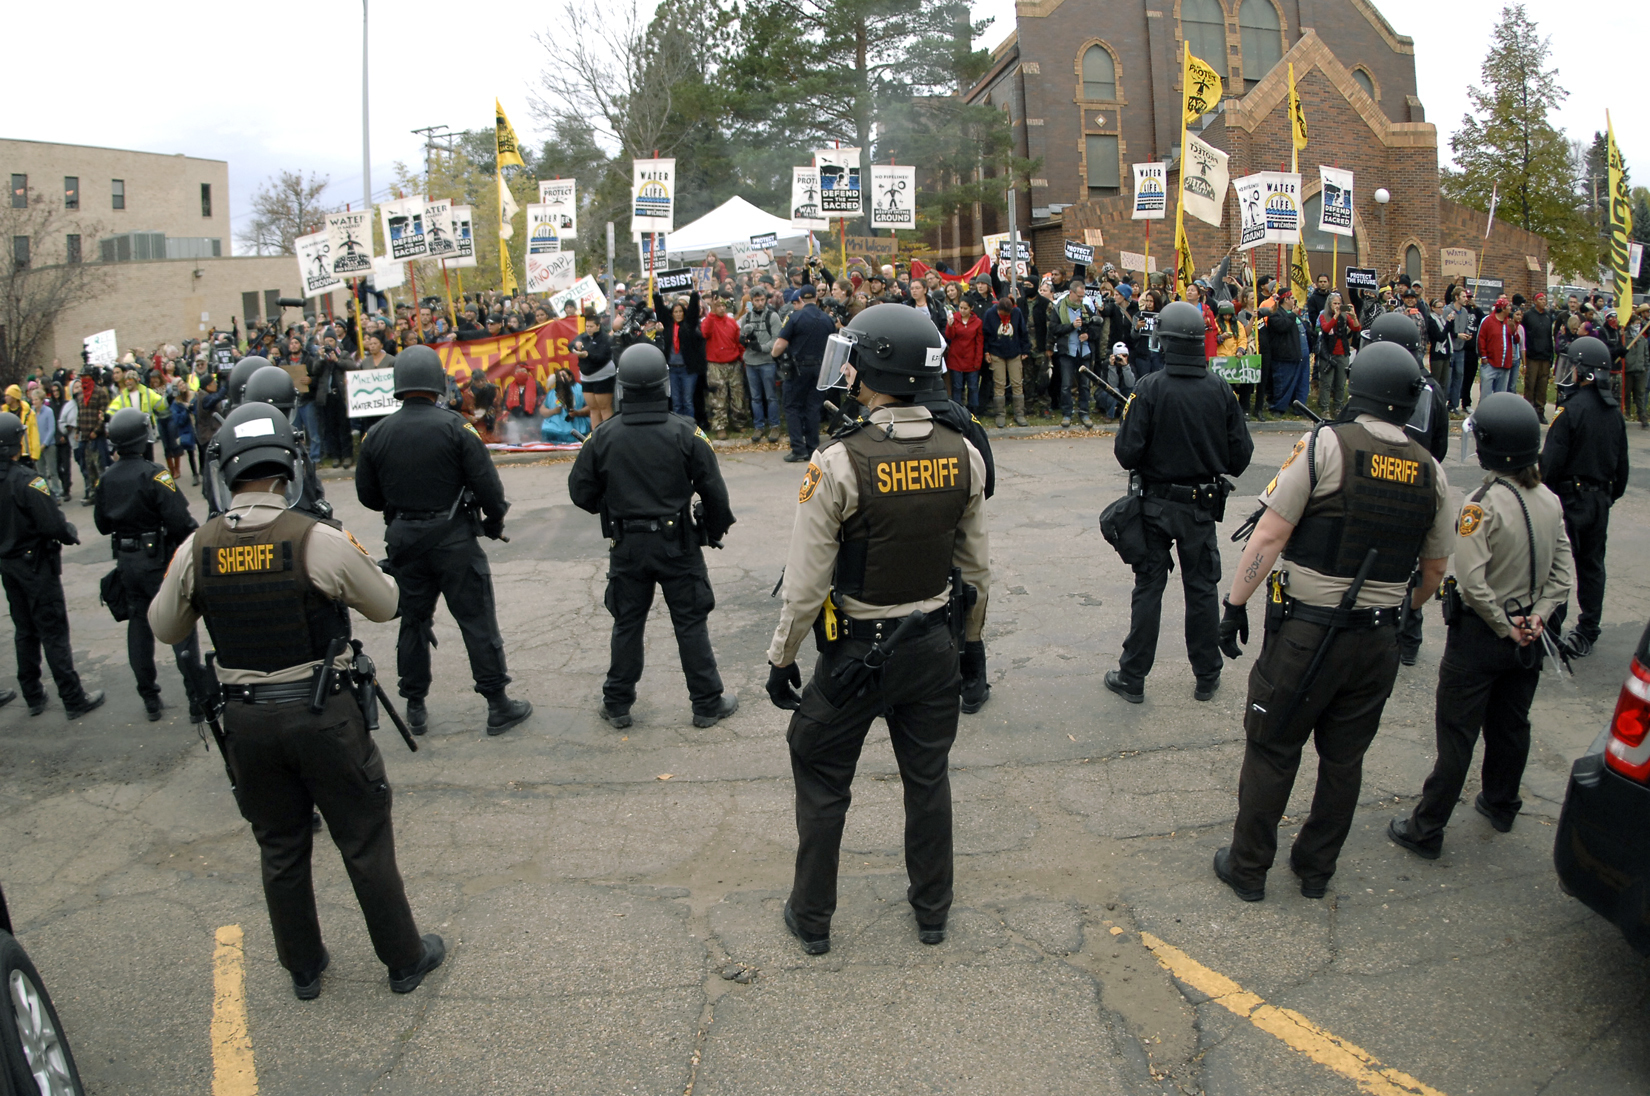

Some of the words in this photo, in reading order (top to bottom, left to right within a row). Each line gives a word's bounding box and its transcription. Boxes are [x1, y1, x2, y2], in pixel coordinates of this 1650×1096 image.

[641, 171, 668, 180] WATER
[1140, 168, 1161, 177] WATER
[645, 187, 662, 197] LIFE
[1144, 183, 1157, 192] LIFE
[1267, 183, 1295, 193] WATER
[425, 205, 447, 214] ATER
[1271, 200, 1288, 209] LIFE
[1325, 205, 1350, 215] DEFEND
[534, 214, 557, 222] WATER
[1324, 215, 1350, 225] SACRED
[393, 234, 424, 246] DEFEND
[394, 245, 425, 257] SACRED
[1003, 244, 1026, 252] HOOR
[1067, 244, 1090, 255] PROTECT
[644, 250, 665, 259] DEEND
[527, 253, 574, 290] #NODAPL
[1350, 272, 1372, 280] PROTECT
[657, 274, 692, 289] RESIST
[553, 280, 591, 308] PROTECT
[546, 337, 570, 358] IS
[371, 372, 394, 382] WICO
[1371, 454, 1419, 484] SHERIFF
[877, 457, 959, 493] SHERIFF
[218, 544, 274, 573] SHERIFF
